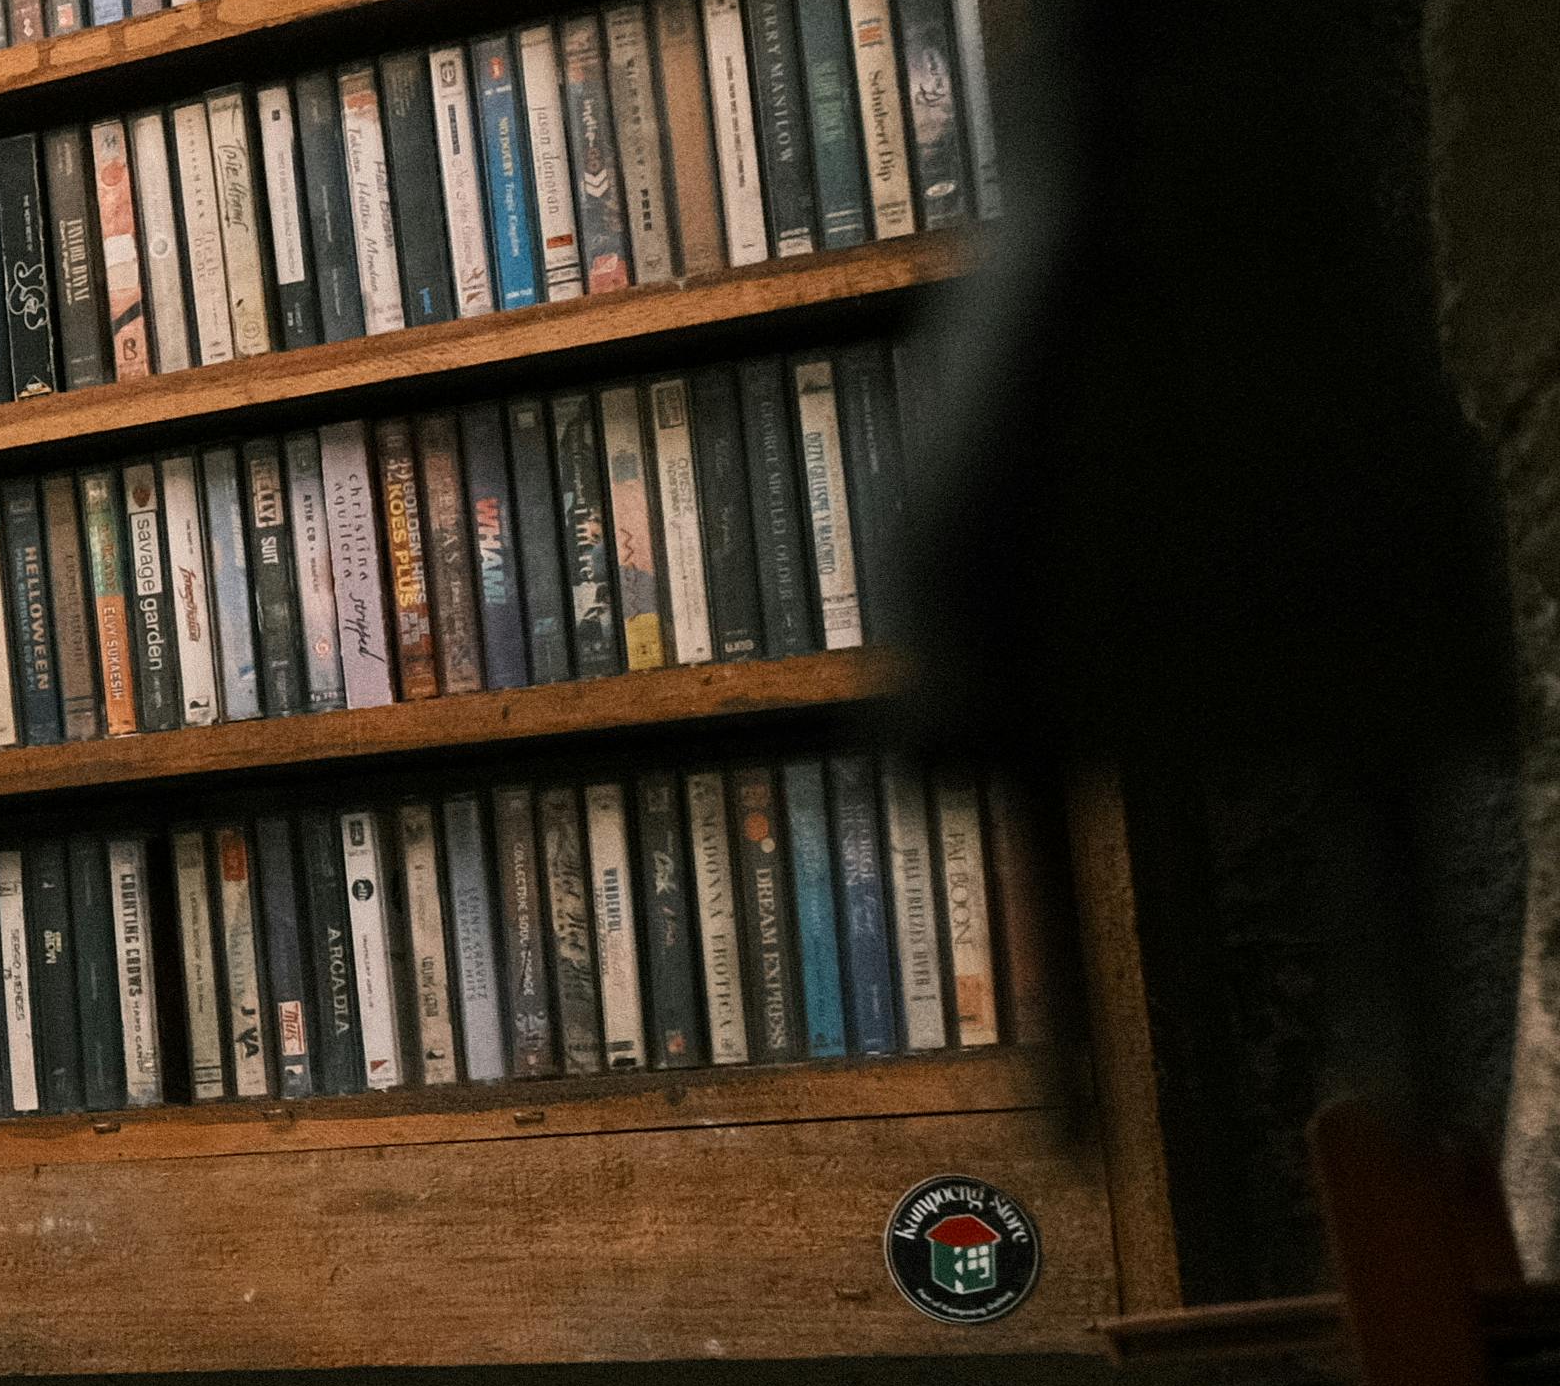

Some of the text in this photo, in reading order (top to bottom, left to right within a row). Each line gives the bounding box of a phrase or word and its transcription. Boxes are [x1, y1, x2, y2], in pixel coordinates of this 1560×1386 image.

[532, 107, 562, 214] jason donovan
[768, 62, 793, 163] MANILOW
[867, 69, 894, 182] Schubert Dip
[507, 214, 520, 257] Kingdom
[333, 483, 353, 579] aguilera
[348, 473, 370, 581] christina
[388, 484, 412, 607] KOES PLUS
[405, 482, 426, 605] GOLDEN HITS
[475, 497, 506, 605] WHAM!
[760, 401, 791, 599] GEORGE MICHAEL OLDER
[25, 546, 49, 691] HELLOWEEN
[134, 519, 164, 670] savage garden
[103, 606, 123, 700] ELVY SUKAESIH
[10, 929, 22, 969] SERGIO
[699, 811, 733, 1027] MADONNA EROTICA
[755, 867, 787, 1048] DREAM EXPRESS
[326, 925, 349, 1036] ARCADIA
